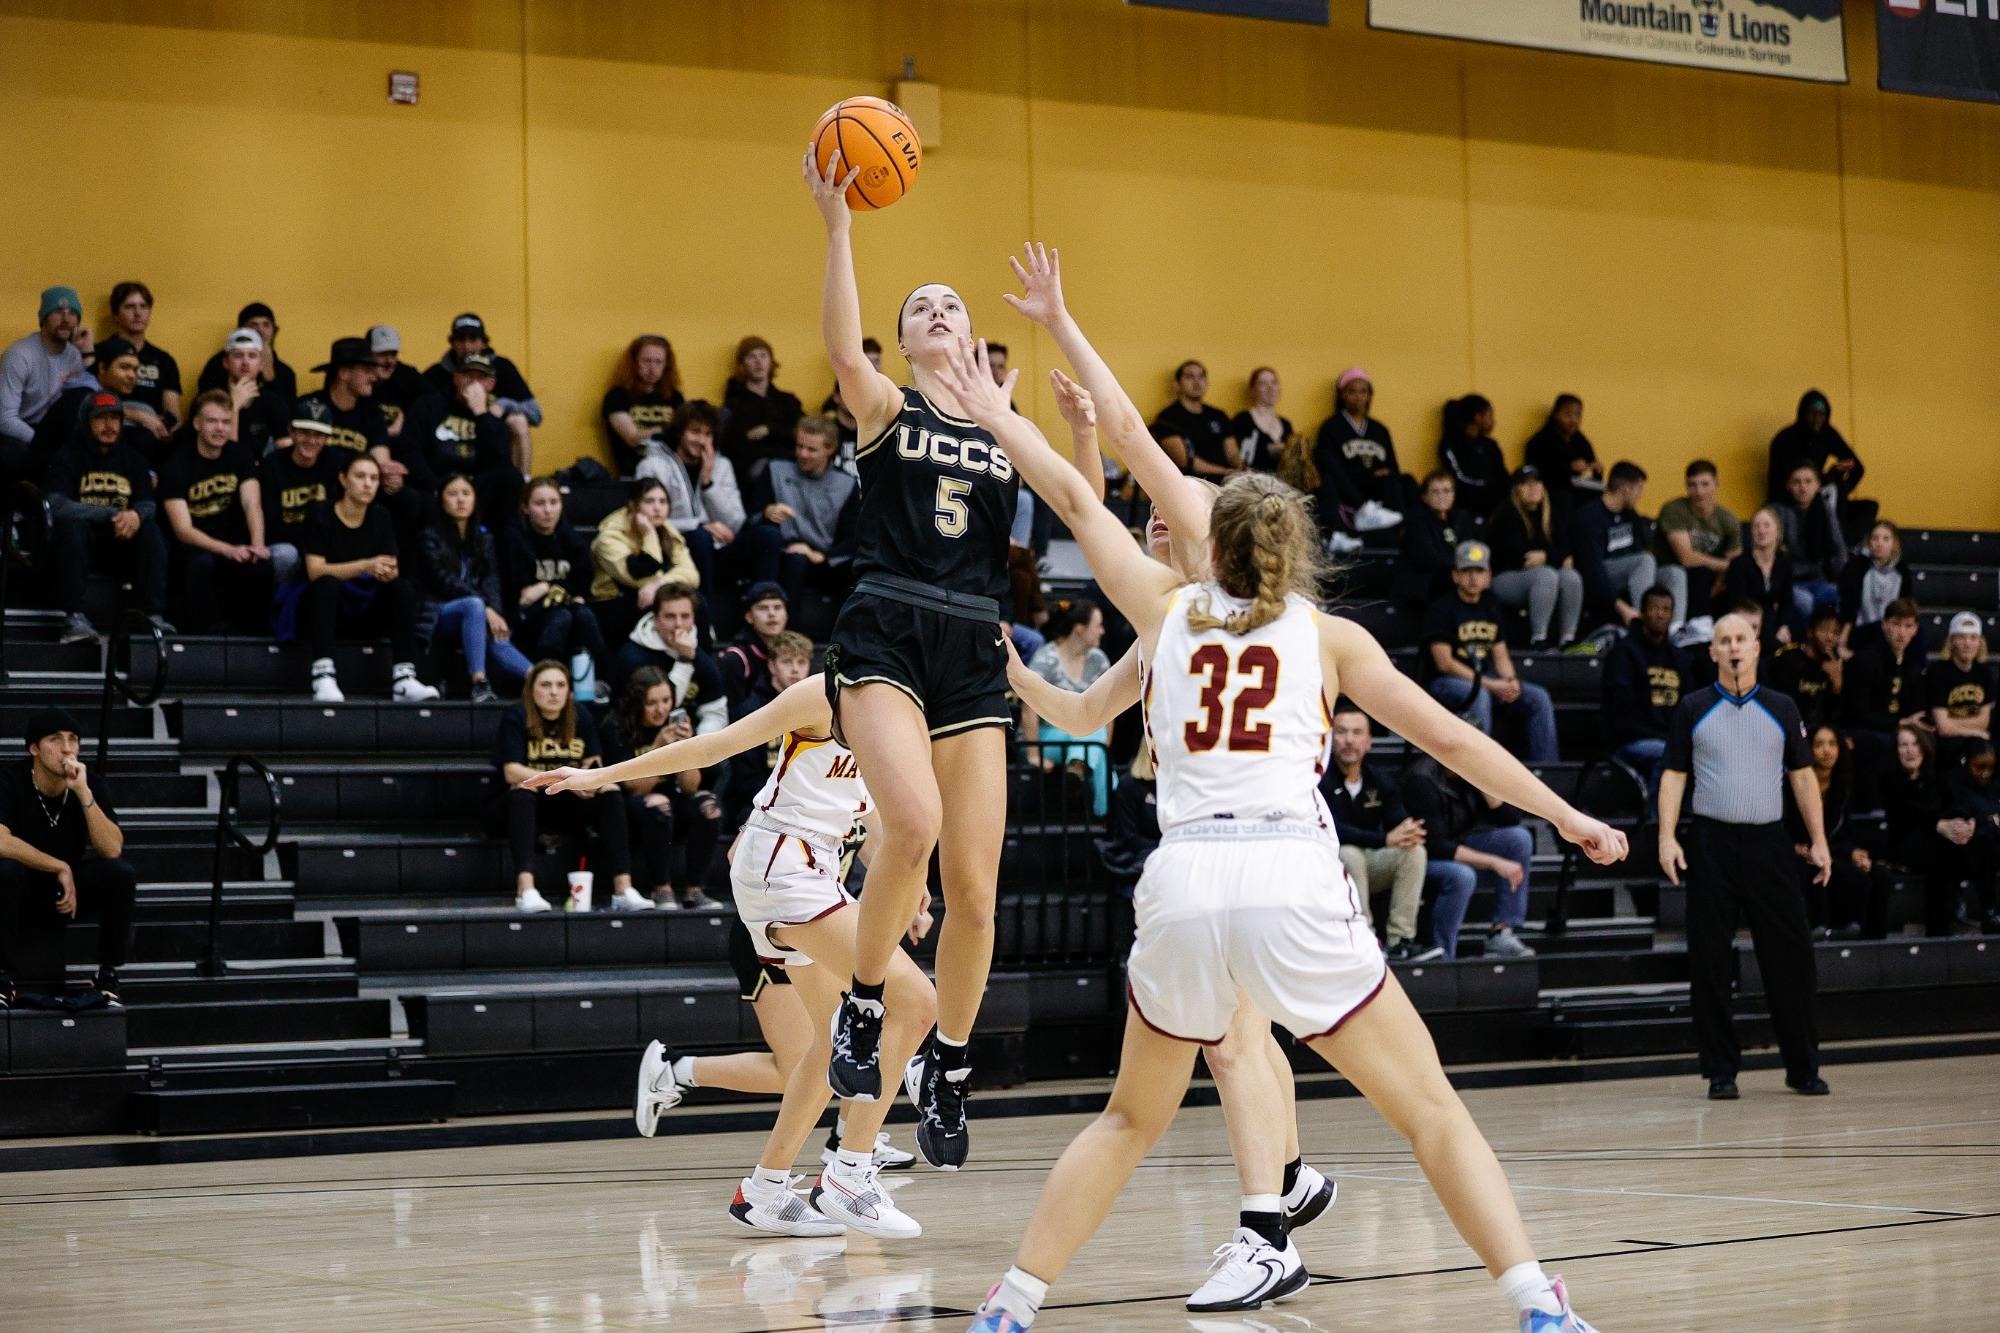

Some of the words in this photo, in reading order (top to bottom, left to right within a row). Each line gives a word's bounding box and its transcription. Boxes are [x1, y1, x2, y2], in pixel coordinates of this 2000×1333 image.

[1580, 0, 1692, 34] Mountain
[1729, 12, 1791, 45] Lions
[896, 423, 1014, 483] UCCS
[80, 470, 132, 497] UCCS
[935, 475, 972, 538] 5
[1184, 643, 1279, 753] 32
